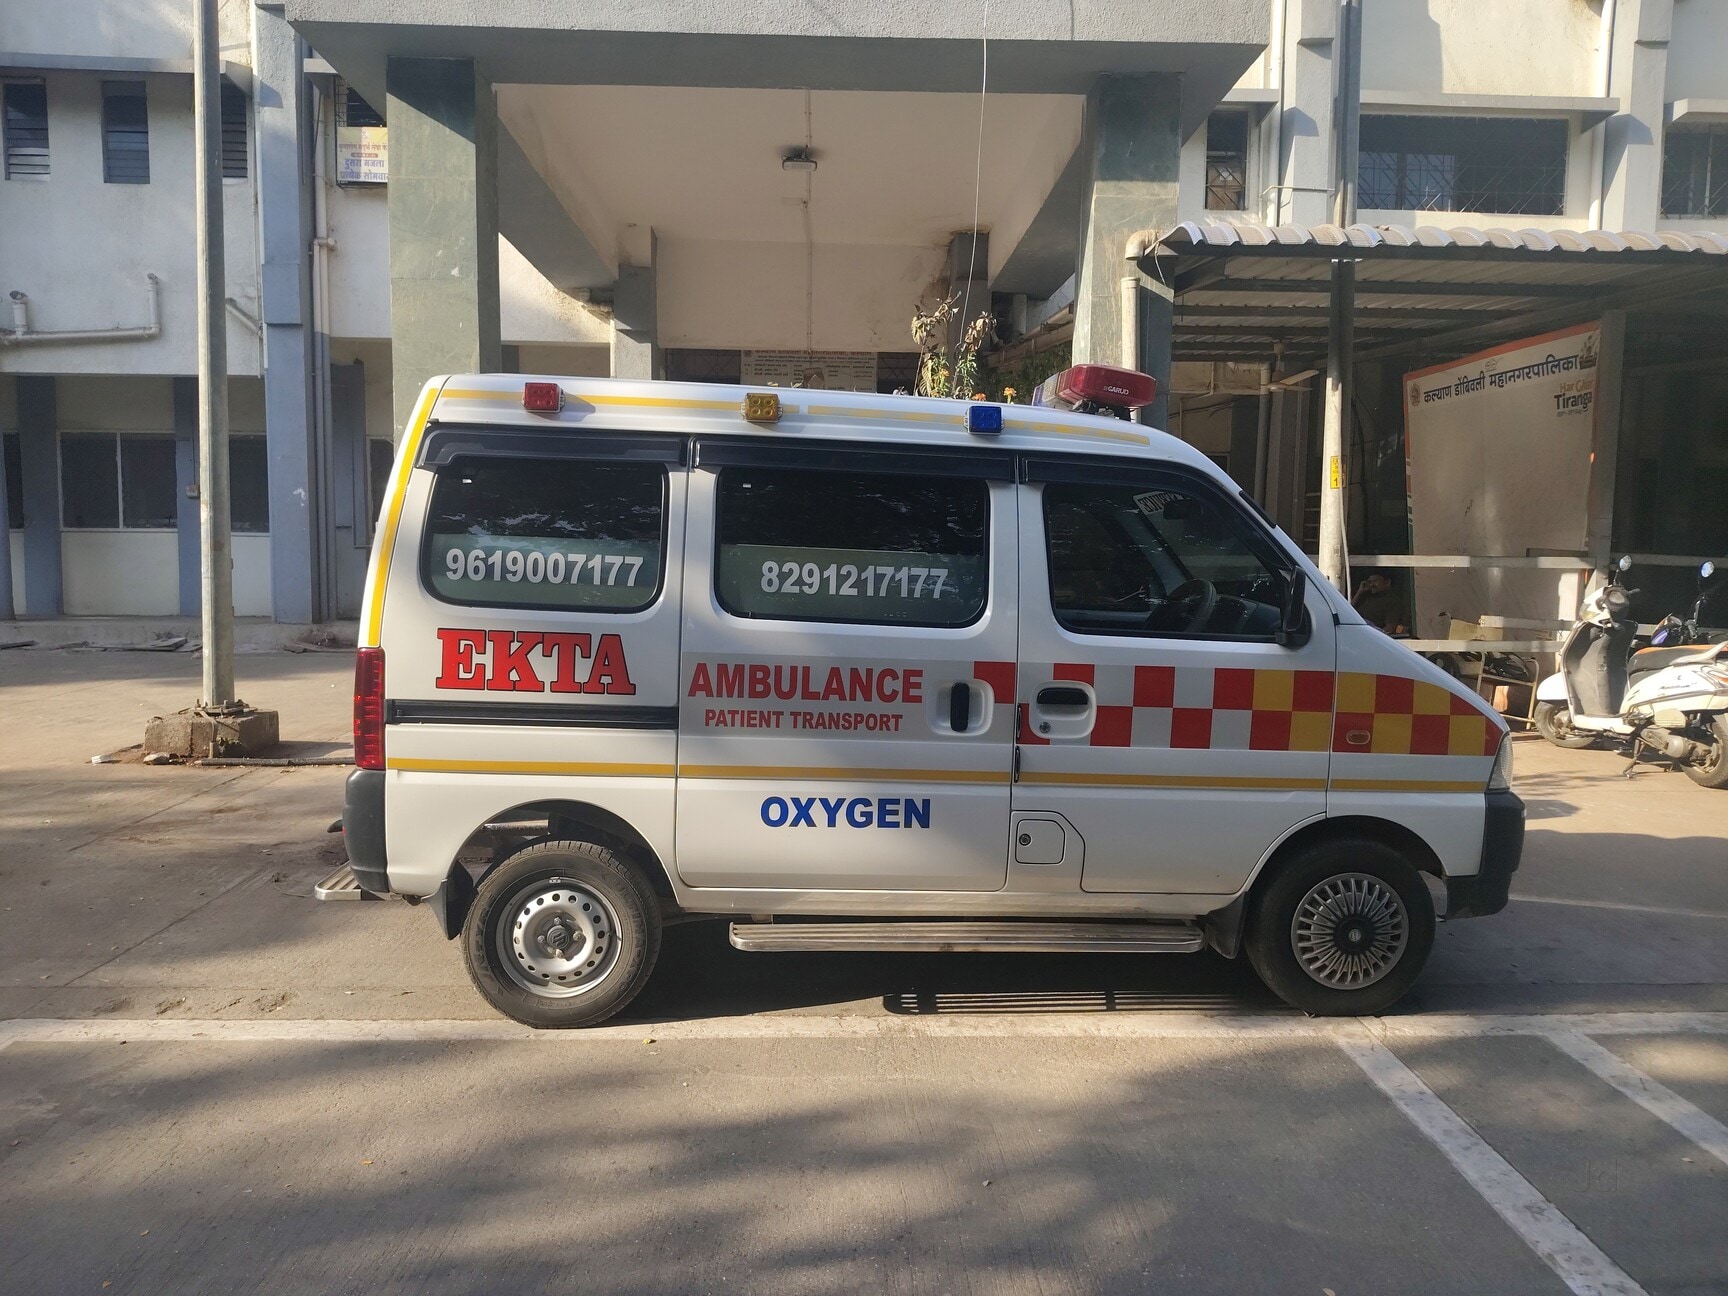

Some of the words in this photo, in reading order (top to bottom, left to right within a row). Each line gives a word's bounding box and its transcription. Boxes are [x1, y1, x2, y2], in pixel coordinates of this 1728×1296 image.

[1108, 385, 1129, 395] GARUD
[1424, 385, 1452, 404] कल्याण
[1454, 371, 1485, 396] डोंबिवली
[1489, 354, 1578, 388] महानगरपालिका
[1560, 382, 1575, 393] Har
[1554, 391, 1592, 412] Tiranga
[446, 549, 644, 587] 9619007177
[760, 560, 949, 599] 8291217177
[436, 628, 636, 695] EKTA
[688, 662, 924, 704] AMBULANCE
[704, 708, 784, 729] PATIENT
[790, 711, 903, 732] TRANSPORT
[760, 796, 931, 829] OXYGEN
